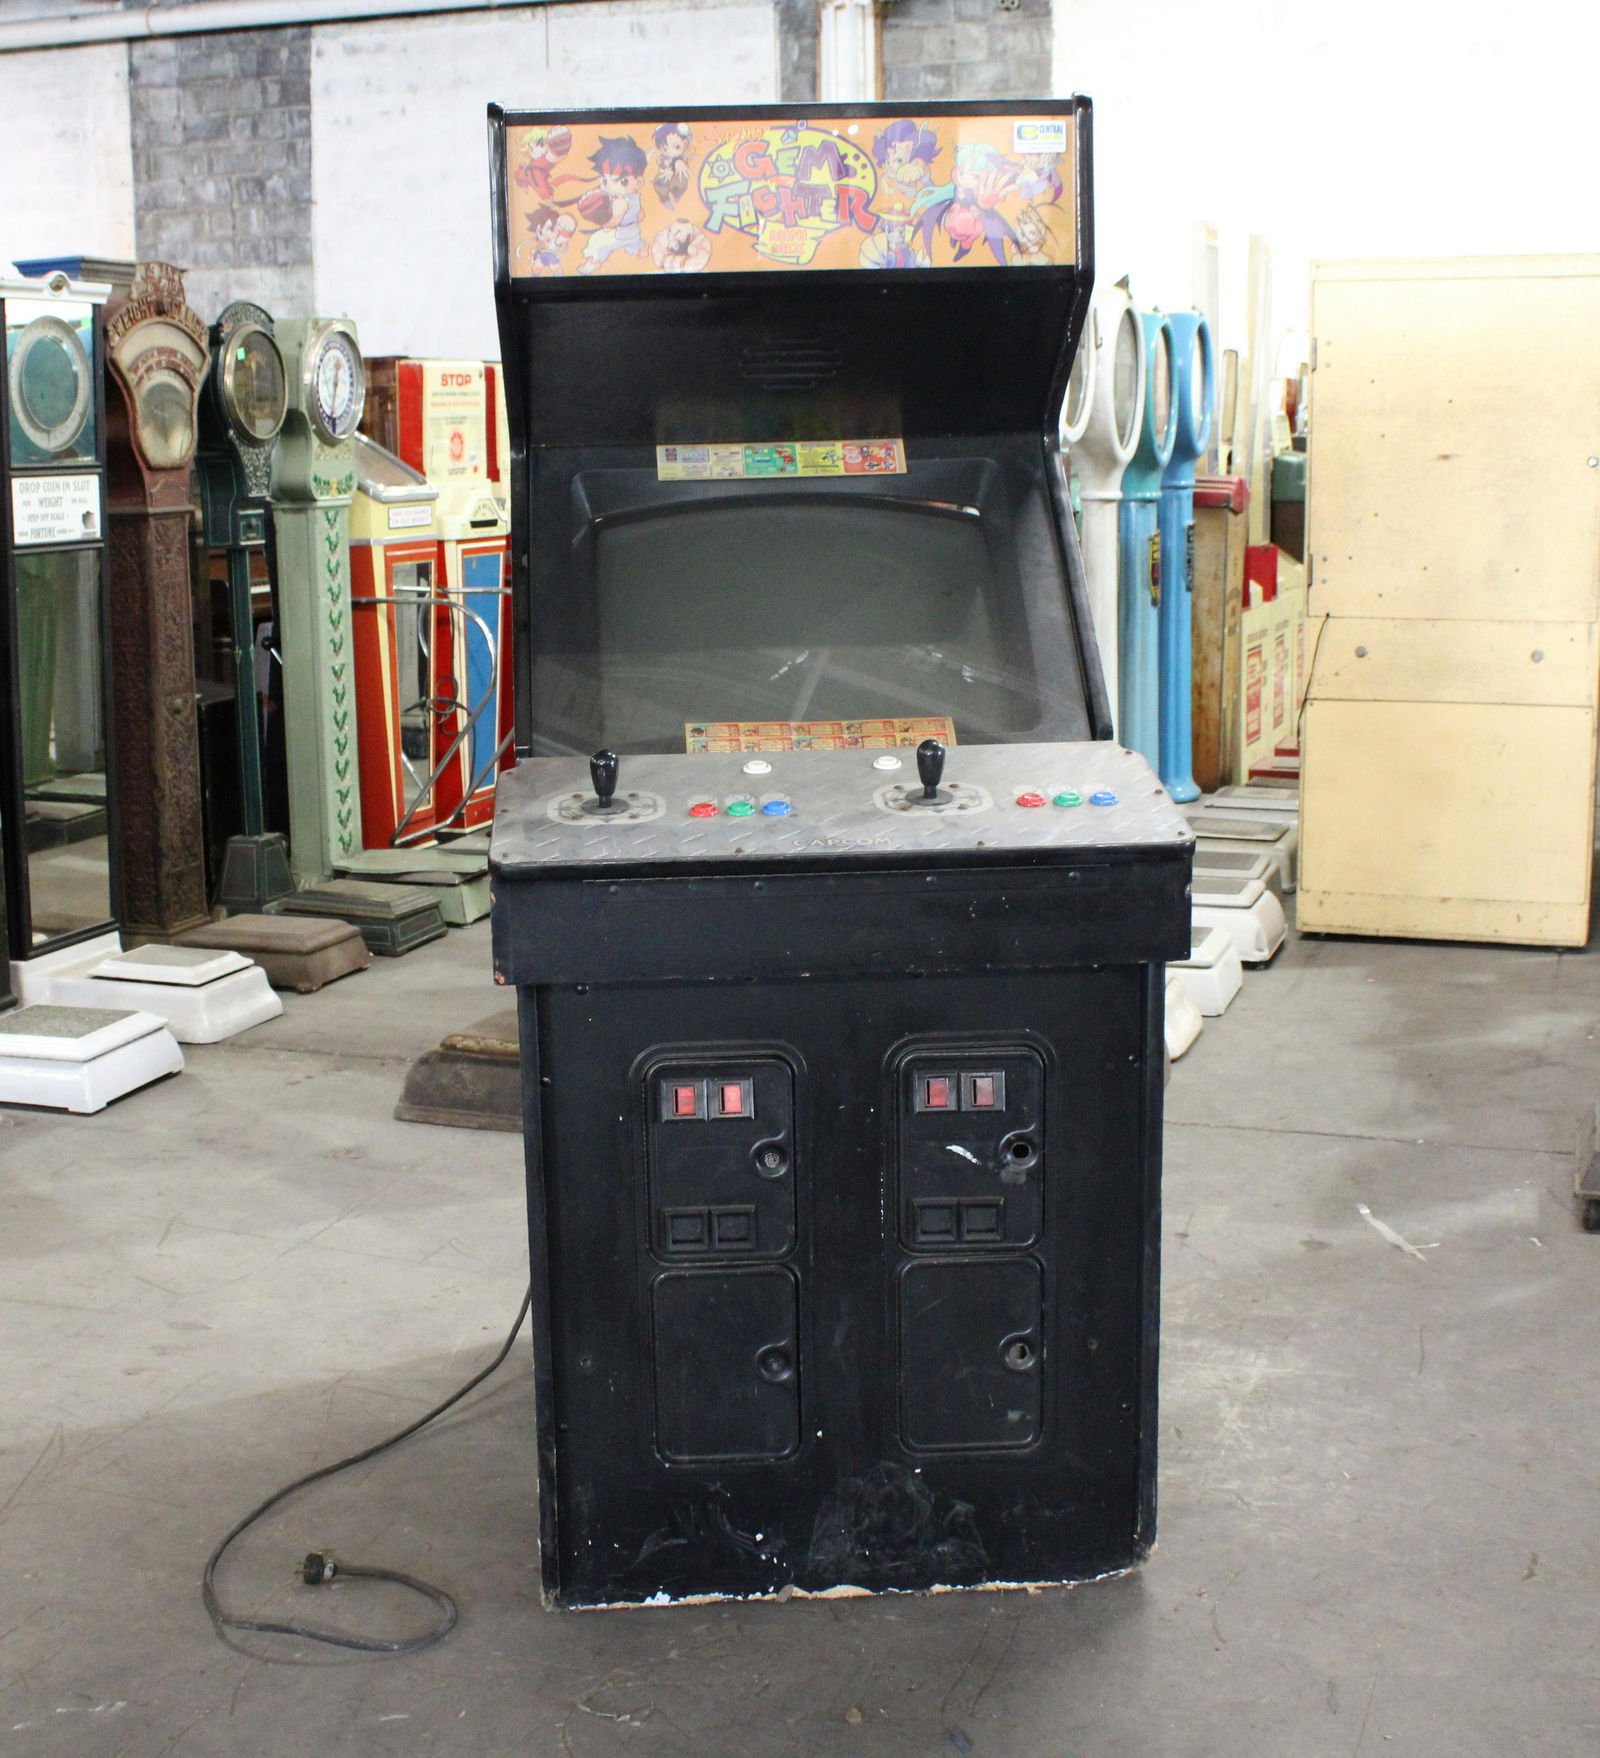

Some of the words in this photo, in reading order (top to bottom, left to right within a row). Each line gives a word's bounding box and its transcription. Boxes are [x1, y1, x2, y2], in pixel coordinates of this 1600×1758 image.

[733, 139, 847, 182] GEM
[703, 180, 881, 235] FIGHTER
[441, 374, 472, 387] STOP
[19, 481, 40, 494] DROP
[43, 481, 60, 493] COIN
[62, 480, 71, 492] IN
[73, 480, 91, 492] SLOT
[38, 496, 63, 508] WEIGHT
[30, 527, 56, 539] FORTUNE
[792, 838, 892, 846] CAPCOM
